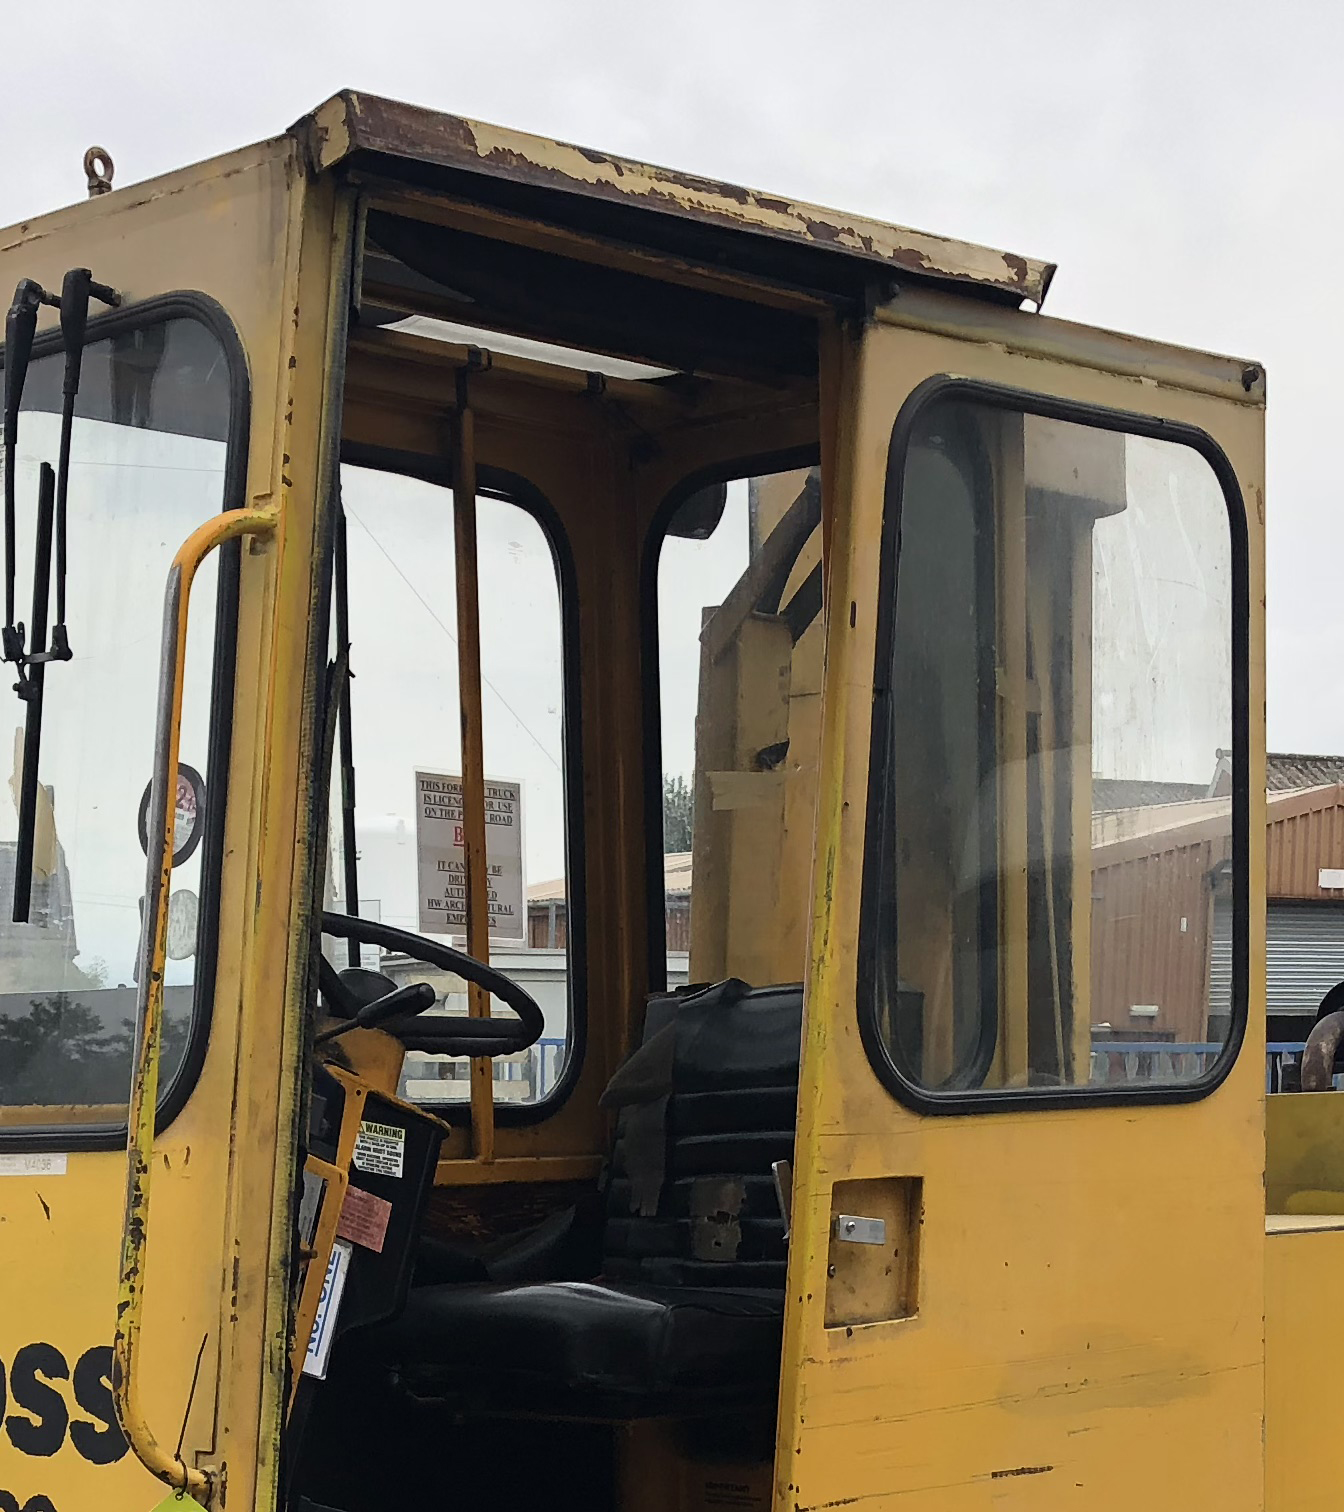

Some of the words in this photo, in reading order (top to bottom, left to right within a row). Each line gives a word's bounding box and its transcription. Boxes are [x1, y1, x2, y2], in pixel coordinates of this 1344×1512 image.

[487, 787, 515, 798] TRUCK
[439, 808, 455, 819] THE
[489, 814, 513, 824] ROAD
[365, 1123, 403, 1140] WARNING
